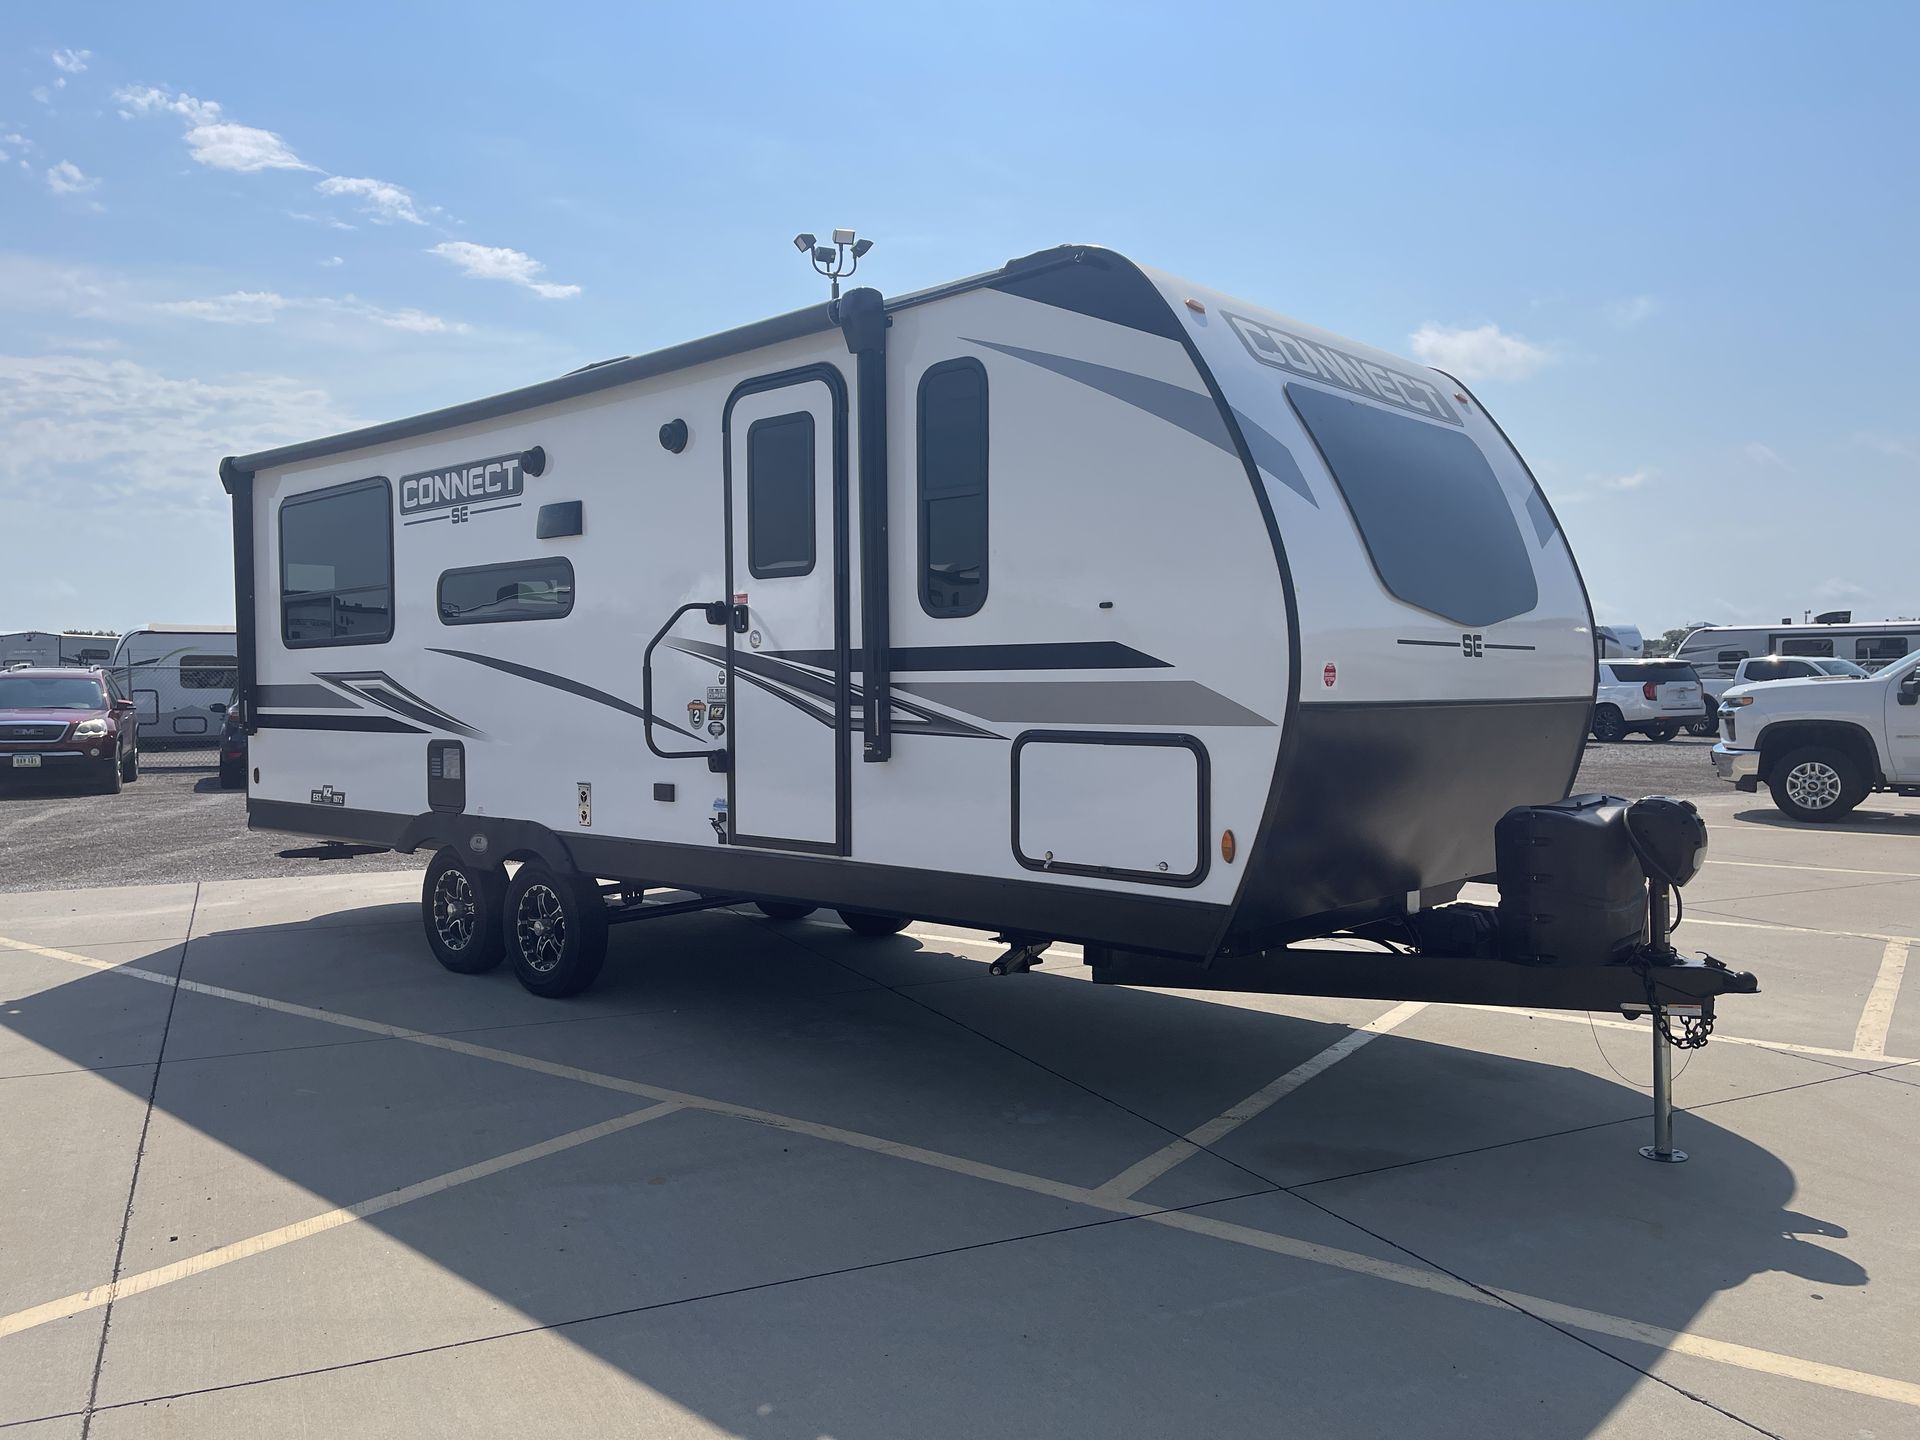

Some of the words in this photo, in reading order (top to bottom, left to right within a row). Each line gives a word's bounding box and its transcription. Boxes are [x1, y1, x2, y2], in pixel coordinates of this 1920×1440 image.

[1231, 317, 1450, 418] CONNECT
[403, 459, 519, 508] CONNECT
[451, 505, 469, 524] SE
[1462, 633, 1484, 659] SE
[694, 710, 700, 722] 2
[711, 707, 724, 717] KZ
